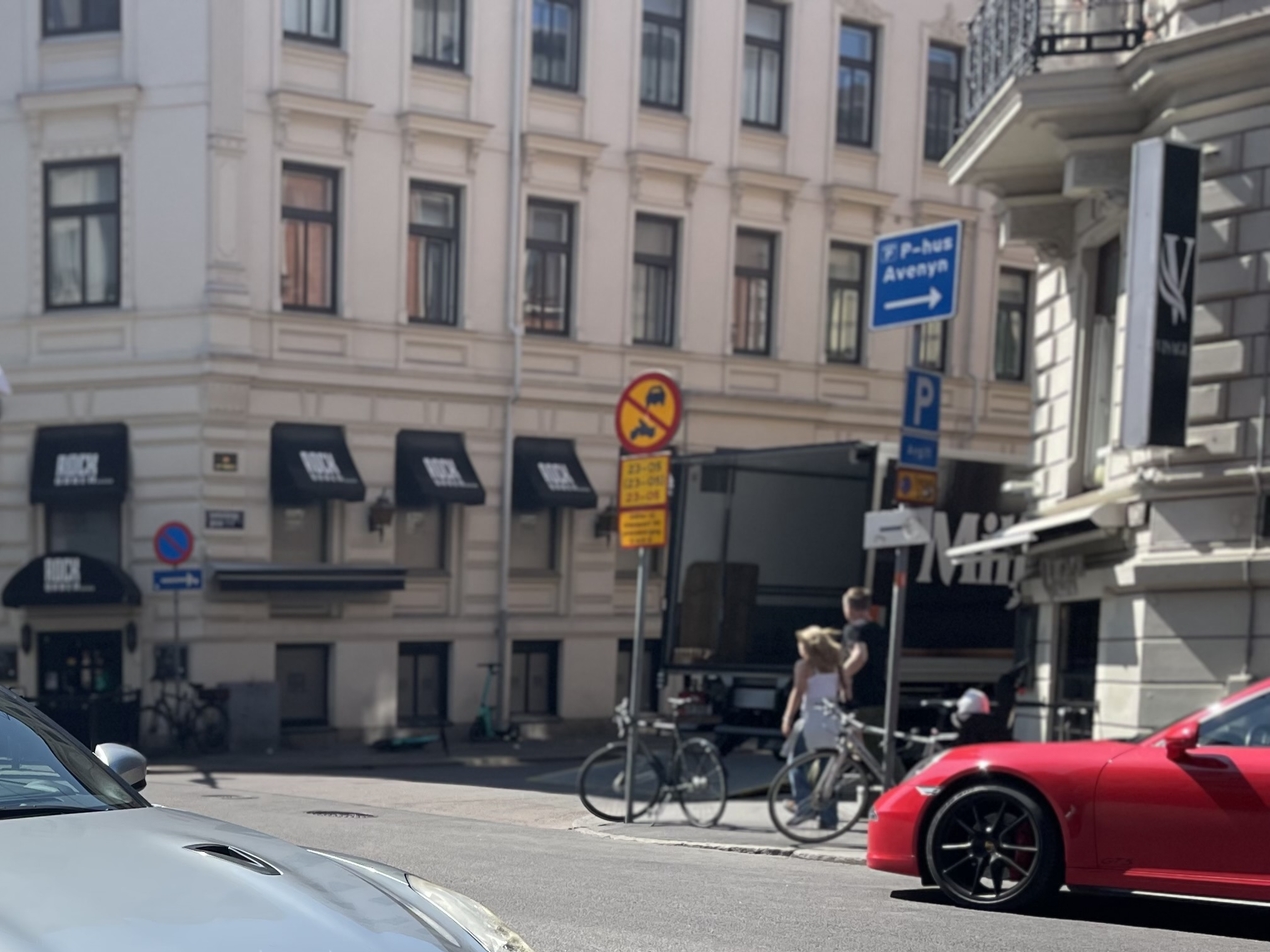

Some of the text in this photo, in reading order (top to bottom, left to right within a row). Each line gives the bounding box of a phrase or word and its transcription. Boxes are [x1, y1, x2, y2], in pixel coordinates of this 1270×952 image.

[901, 237, 953, 259] P-hus
[883, 259, 948, 283] Avenyn
[913, 376, 935, 426] P
